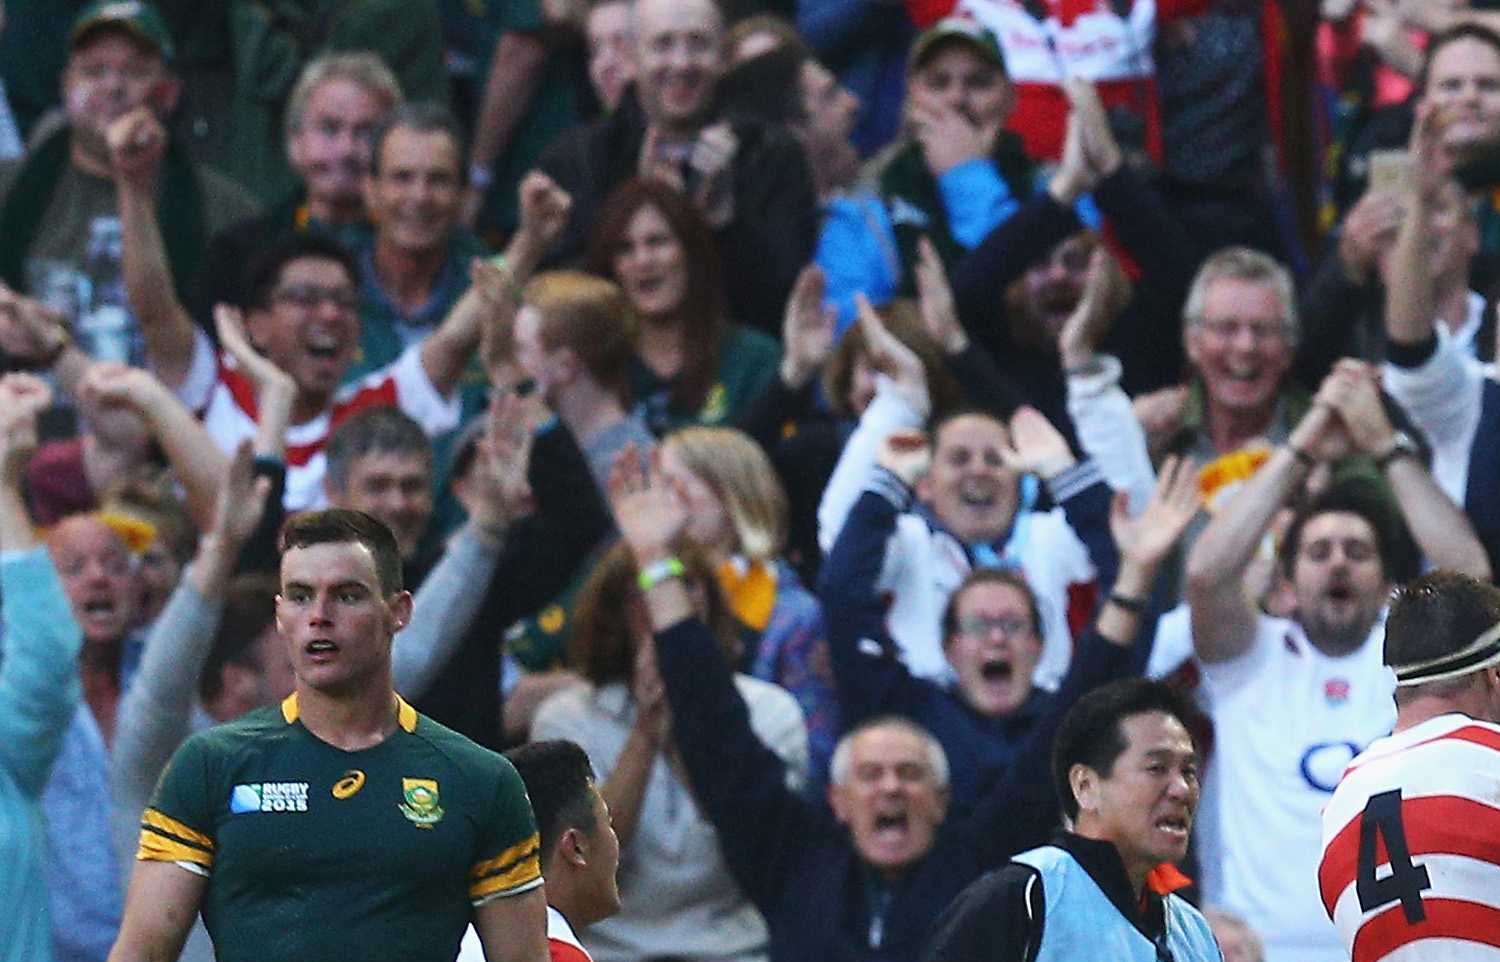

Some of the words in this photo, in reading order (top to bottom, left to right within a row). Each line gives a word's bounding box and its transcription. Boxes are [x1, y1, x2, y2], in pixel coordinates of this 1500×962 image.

[262, 782, 309, 796] RUGBY
[261, 798, 308, 811] 2015
[1355, 787, 1431, 926] 4
